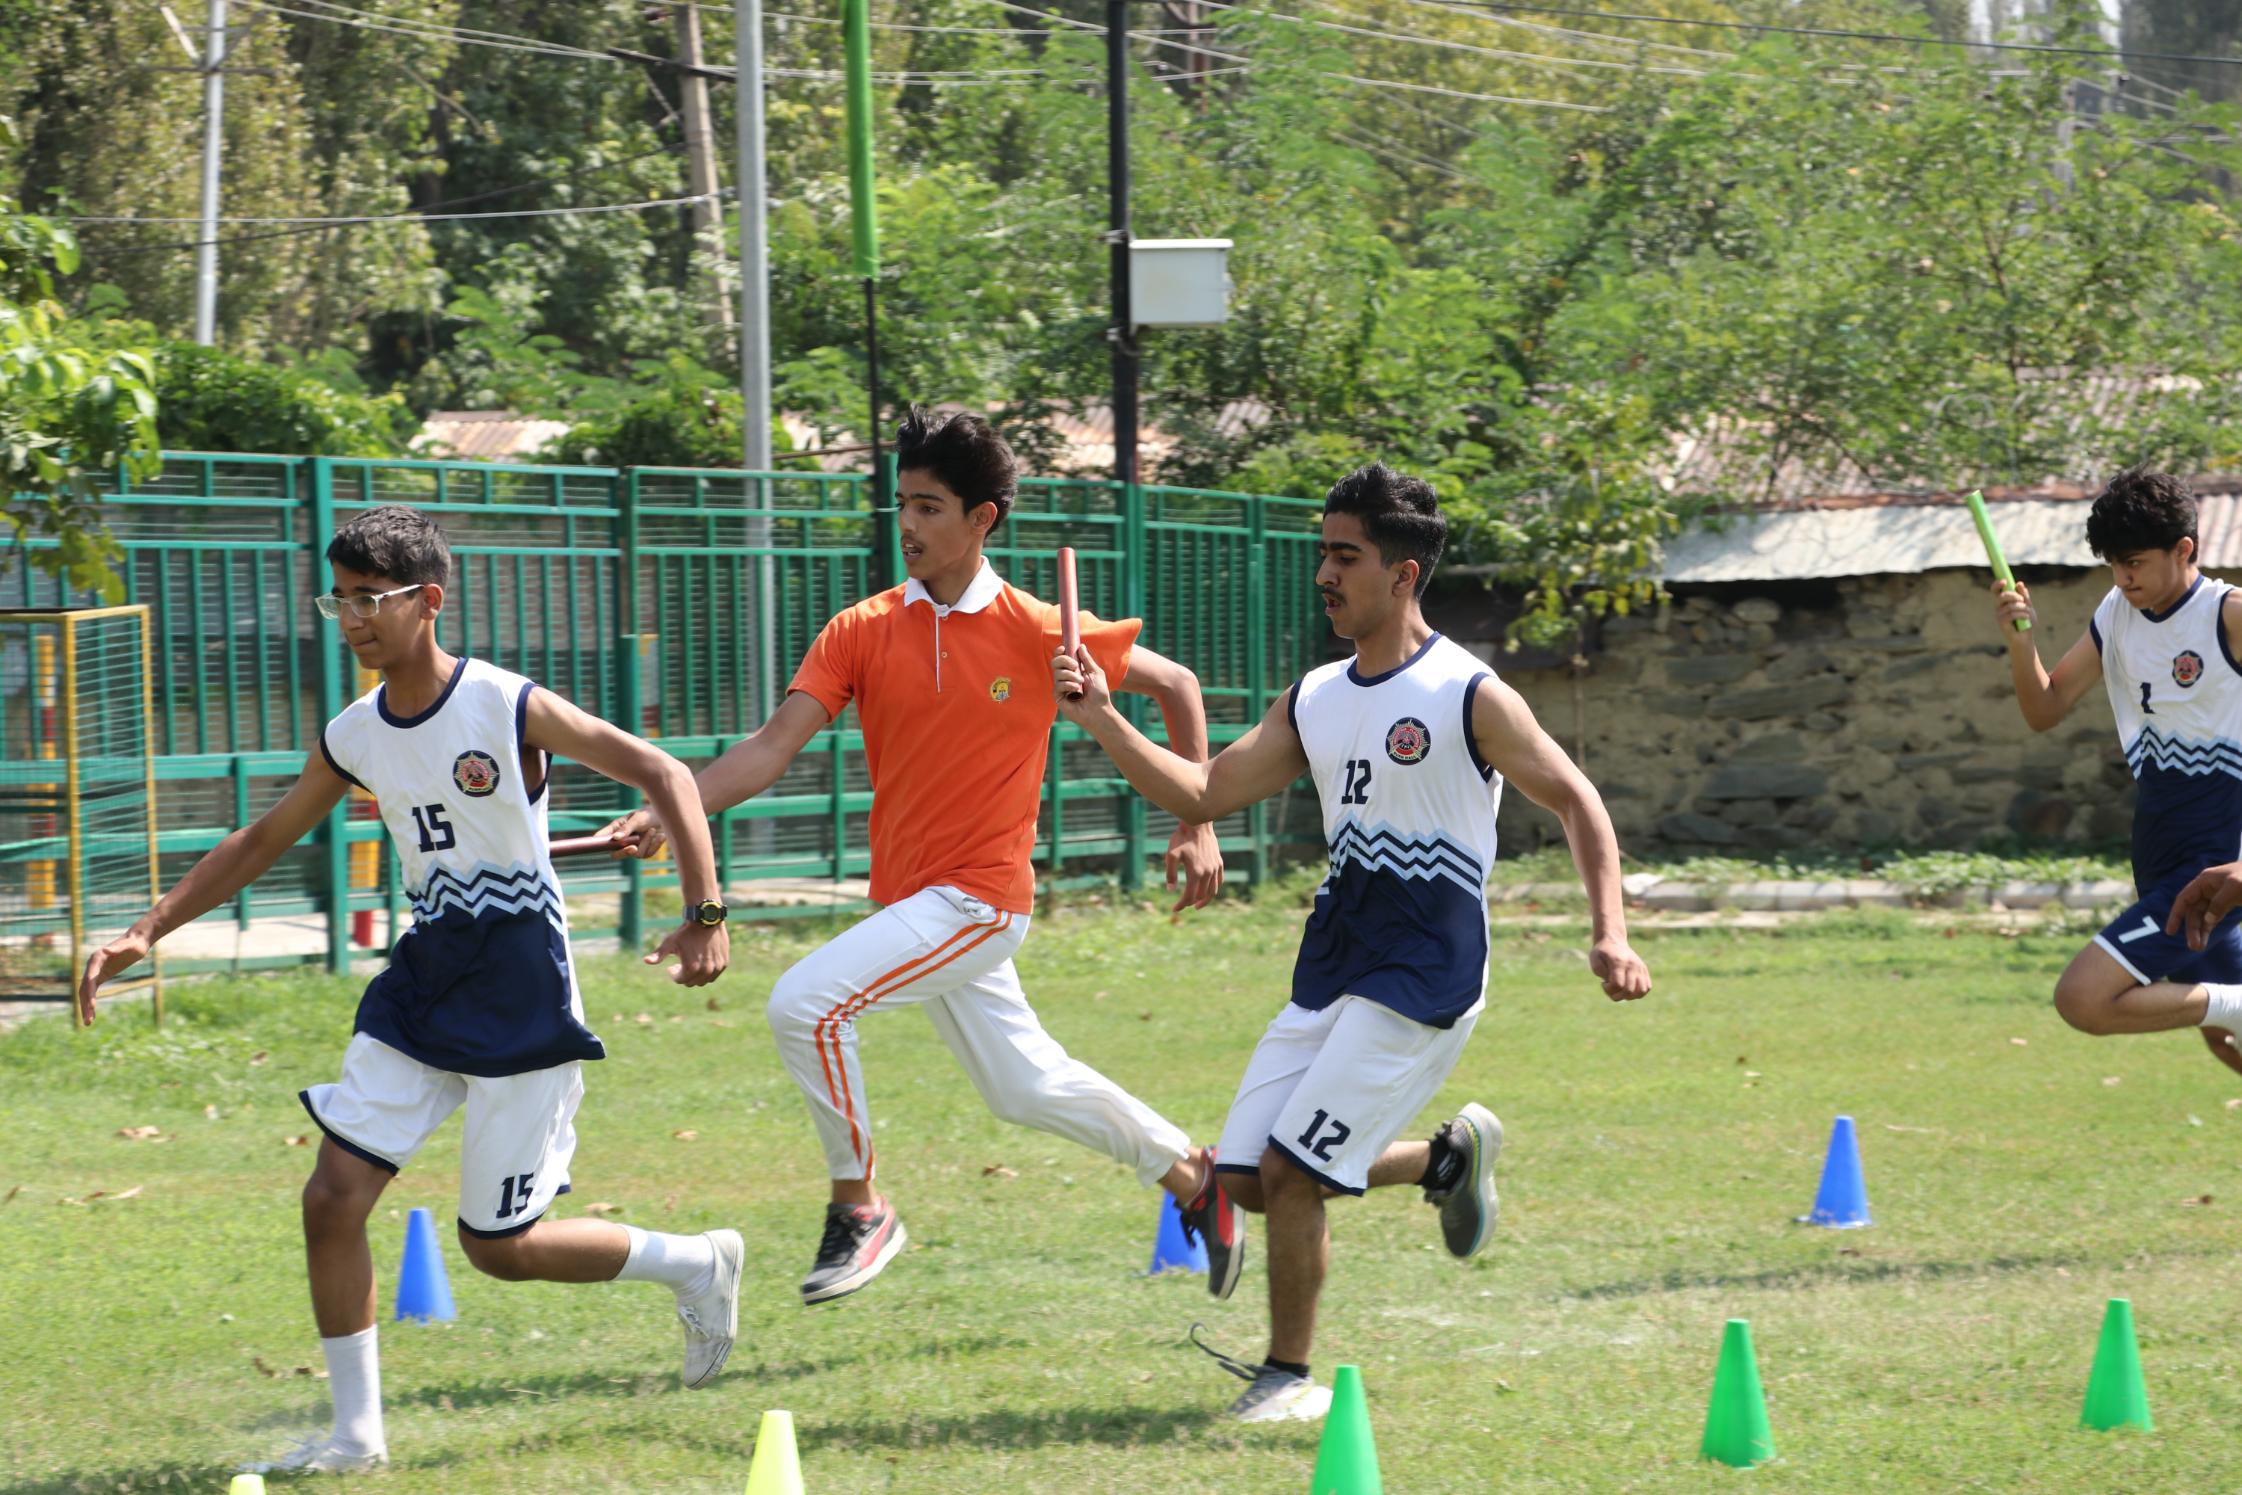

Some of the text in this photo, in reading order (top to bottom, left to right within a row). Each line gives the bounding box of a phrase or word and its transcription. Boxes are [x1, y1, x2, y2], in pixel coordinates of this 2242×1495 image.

[1341, 759, 1371, 804] 12
[412, 803, 455, 852] 15
[1297, 1109, 1350, 1162] 12
[496, 1171, 534, 1218] 15
